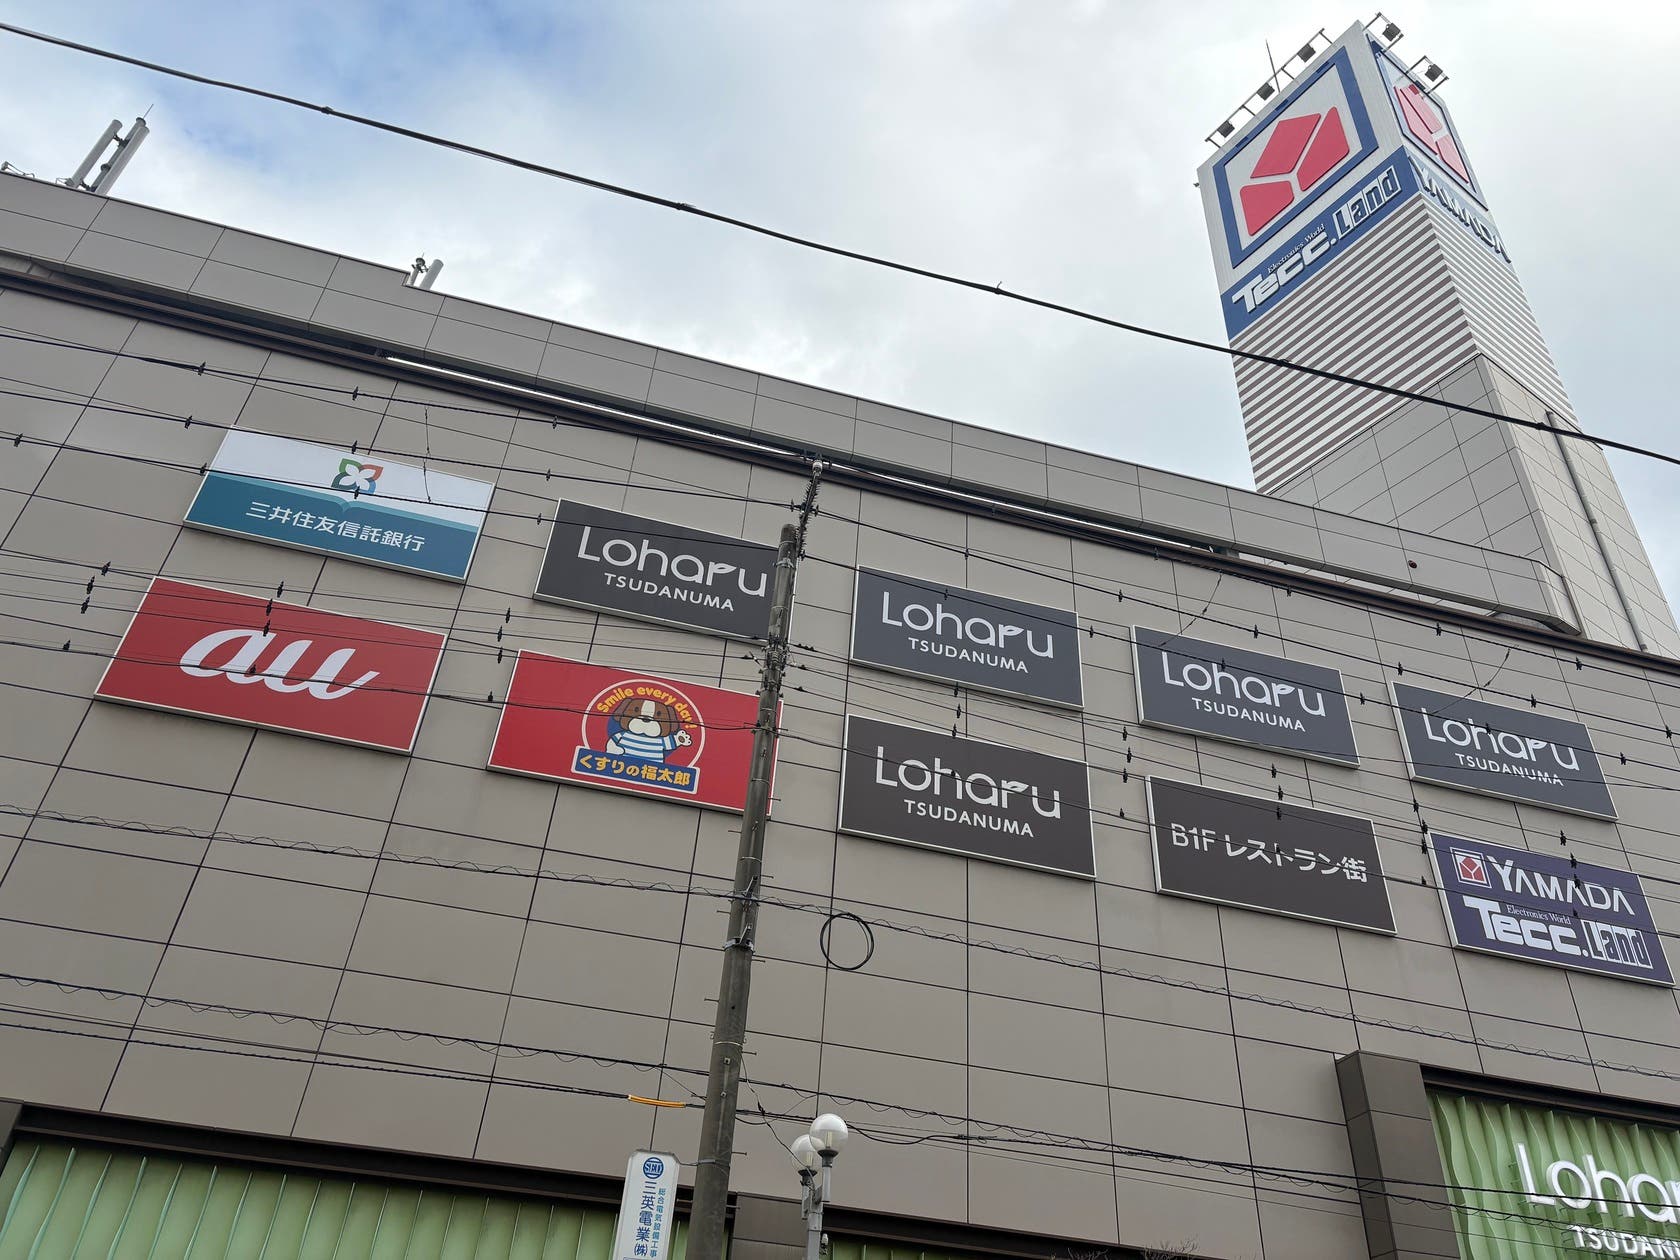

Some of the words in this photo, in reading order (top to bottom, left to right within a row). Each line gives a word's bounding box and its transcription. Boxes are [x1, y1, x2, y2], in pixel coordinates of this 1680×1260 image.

[1304, 223, 1325, 243] World
[245, 500, 425, 553] 三井住友信託銀行
[577, 526, 767, 597] Loharu
[604, 572, 734, 612] TSUDANUMA
[882, 591, 1054, 658] Loharu
[179, 629, 382, 700] au
[908, 637, 1028, 673] TSUDANUMA
[637, 686, 676, 705] every
[674, 703, 698, 729] day!
[1162, 651, 1326, 717] Loharu
[1192, 697, 1306, 732] TSUDANUMA
[1421, 707, 1580, 771] Loharu
[579, 754, 691, 786] くすりの福太郎
[875, 745, 1061, 819] Loharu
[1454, 752, 1564, 786] TSUDANUMA
[904, 799, 1034, 838] TSUDANUMA
[1170, 823, 1216, 851] B1F
[1224, 833, 1368, 883] レストラン街
[1487, 855, 1635, 916] YAMADA
[1506, 904, 1550, 921] Electronics
[1550, 912, 1572, 925] World
